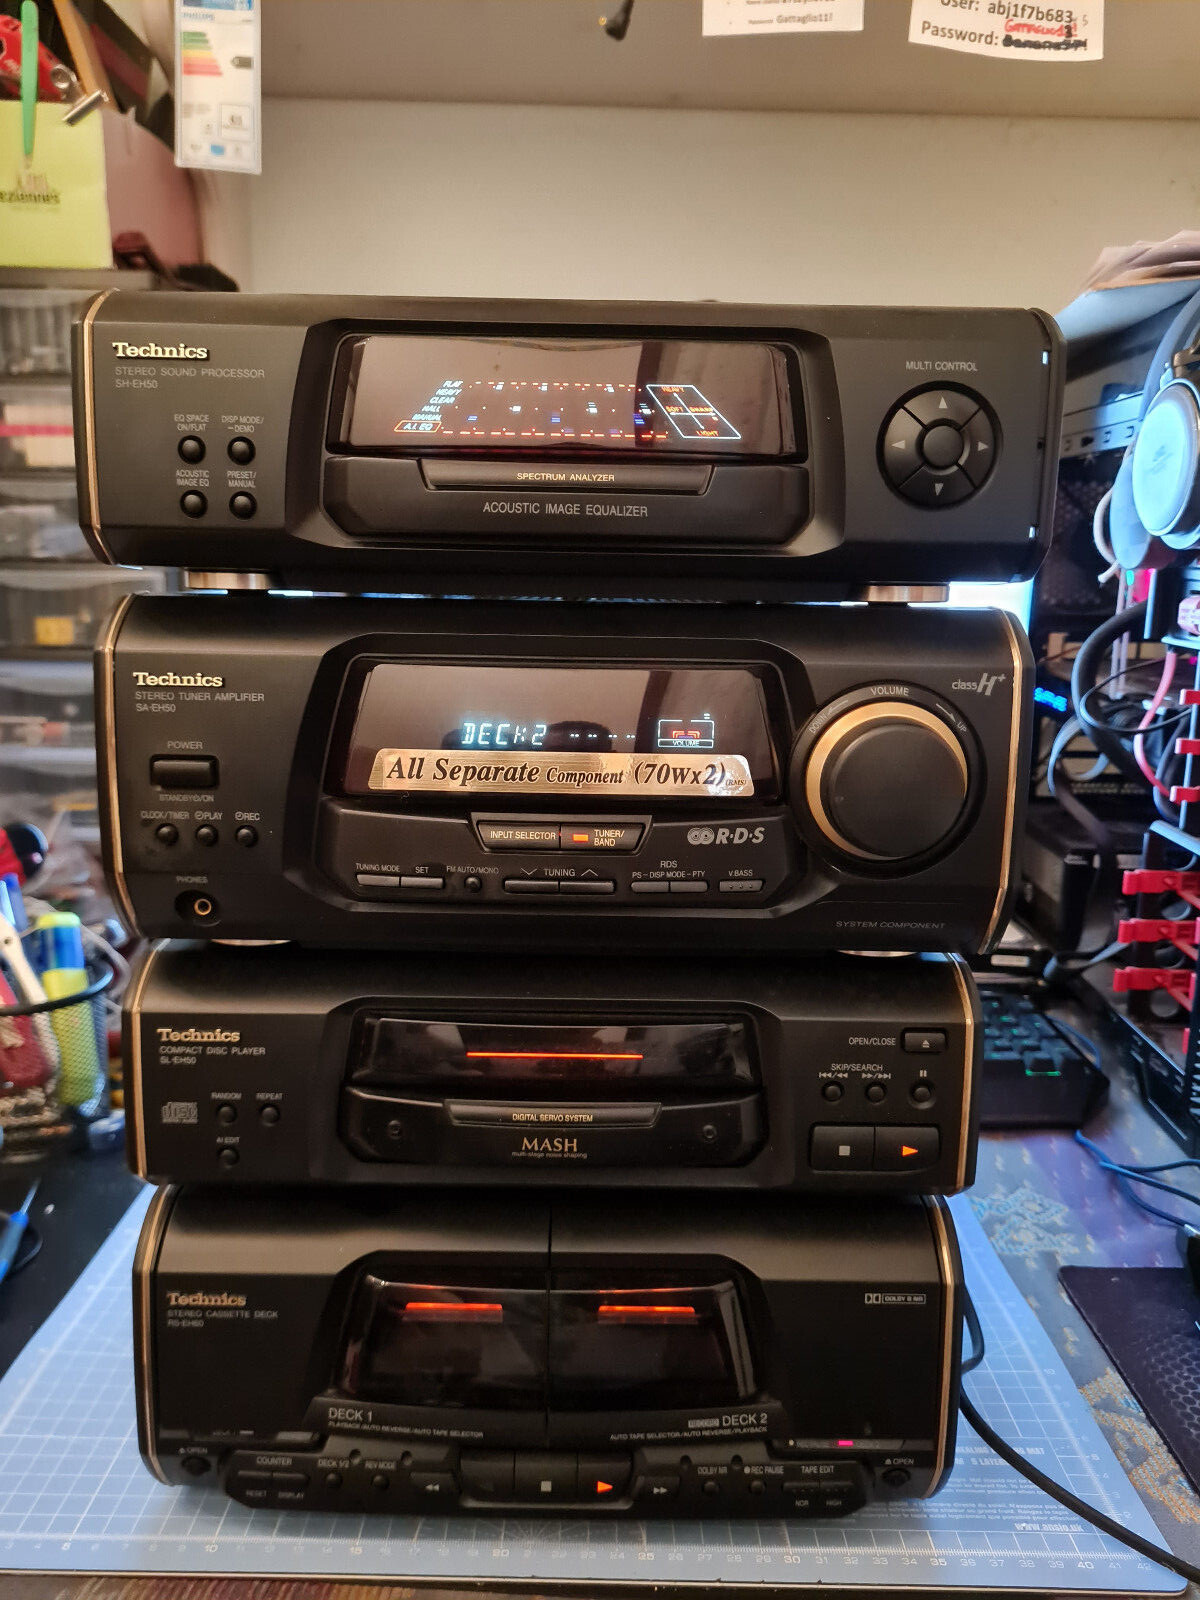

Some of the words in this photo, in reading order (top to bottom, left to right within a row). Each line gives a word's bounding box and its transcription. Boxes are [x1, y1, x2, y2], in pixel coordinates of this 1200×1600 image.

[988, 2, 1073, 22] abj1f7b683
[922, 21, 998, 45] Password:
[112, 342, 208, 359] Technics
[906, 361, 932, 370] MULTI
[935, 362, 978, 371] CONTROL
[115, 367, 156, 376] STEREO
[161, 368, 196, 377] SOUND
[201, 369, 265, 379] PROCESSOR
[115, 379, 158, 389] SH-EH50
[174, 414, 185, 423] EQ
[186, 414, 209, 423] SPACE
[221, 416, 238, 424] DISP
[240, 416, 264, 425] MODE/
[176, 470, 209, 478] ACOUSTIC
[226, 471, 257, 479] PRESET/
[517, 473, 565, 481] SPECTRUM
[570, 474, 615, 482] ANALYZER
[177, 479, 198, 487] IMAGE
[199, 479, 209, 487] EQ
[228, 480, 256, 488] MANUAL
[483, 502, 540, 513] ACOUSTIC
[546, 504, 580, 515] IMAGE
[586, 505, 648, 516] EQUALIZER
[133, 672, 223, 687] Technics
[870, 686, 910, 696] VOLUME
[135, 692, 174, 700] STEREO
[179, 693, 210, 701] TUNER
[215, 693, 265, 702] AMPLIFIER
[136, 704, 176, 712] SA-EH50
[957, 721, 968, 734] UP
[167, 741, 203, 750] POWER
[386, 757, 425, 780] All
[433, 757, 541, 787] Separate
[546, 767, 624, 788] Component
[490, 831, 513, 839] INPUT
[515, 831, 556, 840] SELECTOR
[594, 830, 625, 838] TUNER/
[594, 838, 615, 847] BAND
[355, 863, 380, 872] TUNING
[381, 864, 400, 872] MODE
[660, 860, 677, 868] RDS
[457, 866, 499, 874] AUTO/MONO
[544, 868, 575, 877] TUNING
[650, 871, 665, 879] DISP
[666, 871, 685, 879] MODE
[880, 921, 945, 929] COMPONENT
[157, 1028, 240, 1042] Technics
[848, 1037, 896, 1046] OPEN/CLOSE
[159, 1046, 202, 1054] COMPACT
[206, 1046, 228, 1054] DISC
[231, 1047, 265, 1055] PLAYER
[831, 1063, 883, 1071] SKIP/SEARCH
[256, 1092, 283, 1100] REPEAT
[512, 1113, 538, 1121] DIGITAL
[540, 1114, 563, 1122] SERVO
[565, 1114, 593, 1122] SYSTEM
[521, 1137, 578, 1152] MASH
[166, 1291, 247, 1306] Technics
[167, 1309, 202, 1318] STEREO
[206, 1310, 250, 1318] CASSETTE
[254, 1310, 279, 1318] DECK
[328, 1407, 363, 1421] DECK
[368, 1410, 373, 1421] 1
[722, 1414, 756, 1427] DECK
[760, 1412, 768, 1424] 2
[256, 1456, 292, 1466] COUNTER
[801, 1466, 817, 1474] TAPE
[819, 1465, 834, 1473] EDIT
[784, 1555, 801, 1564] 30
[843, 1556, 859, 1565] 32
[872, 1556, 889, 1565] 33
[901, 1556, 918, 1565] 34
[930, 1558, 947, 1566] 35
[960, 1558, 977, 1567] 36
[989, 1559, 1005, 1567] 37
[1048, 1560, 1065, 1569] 39
[1077, 1561, 1095, 1570] 40
